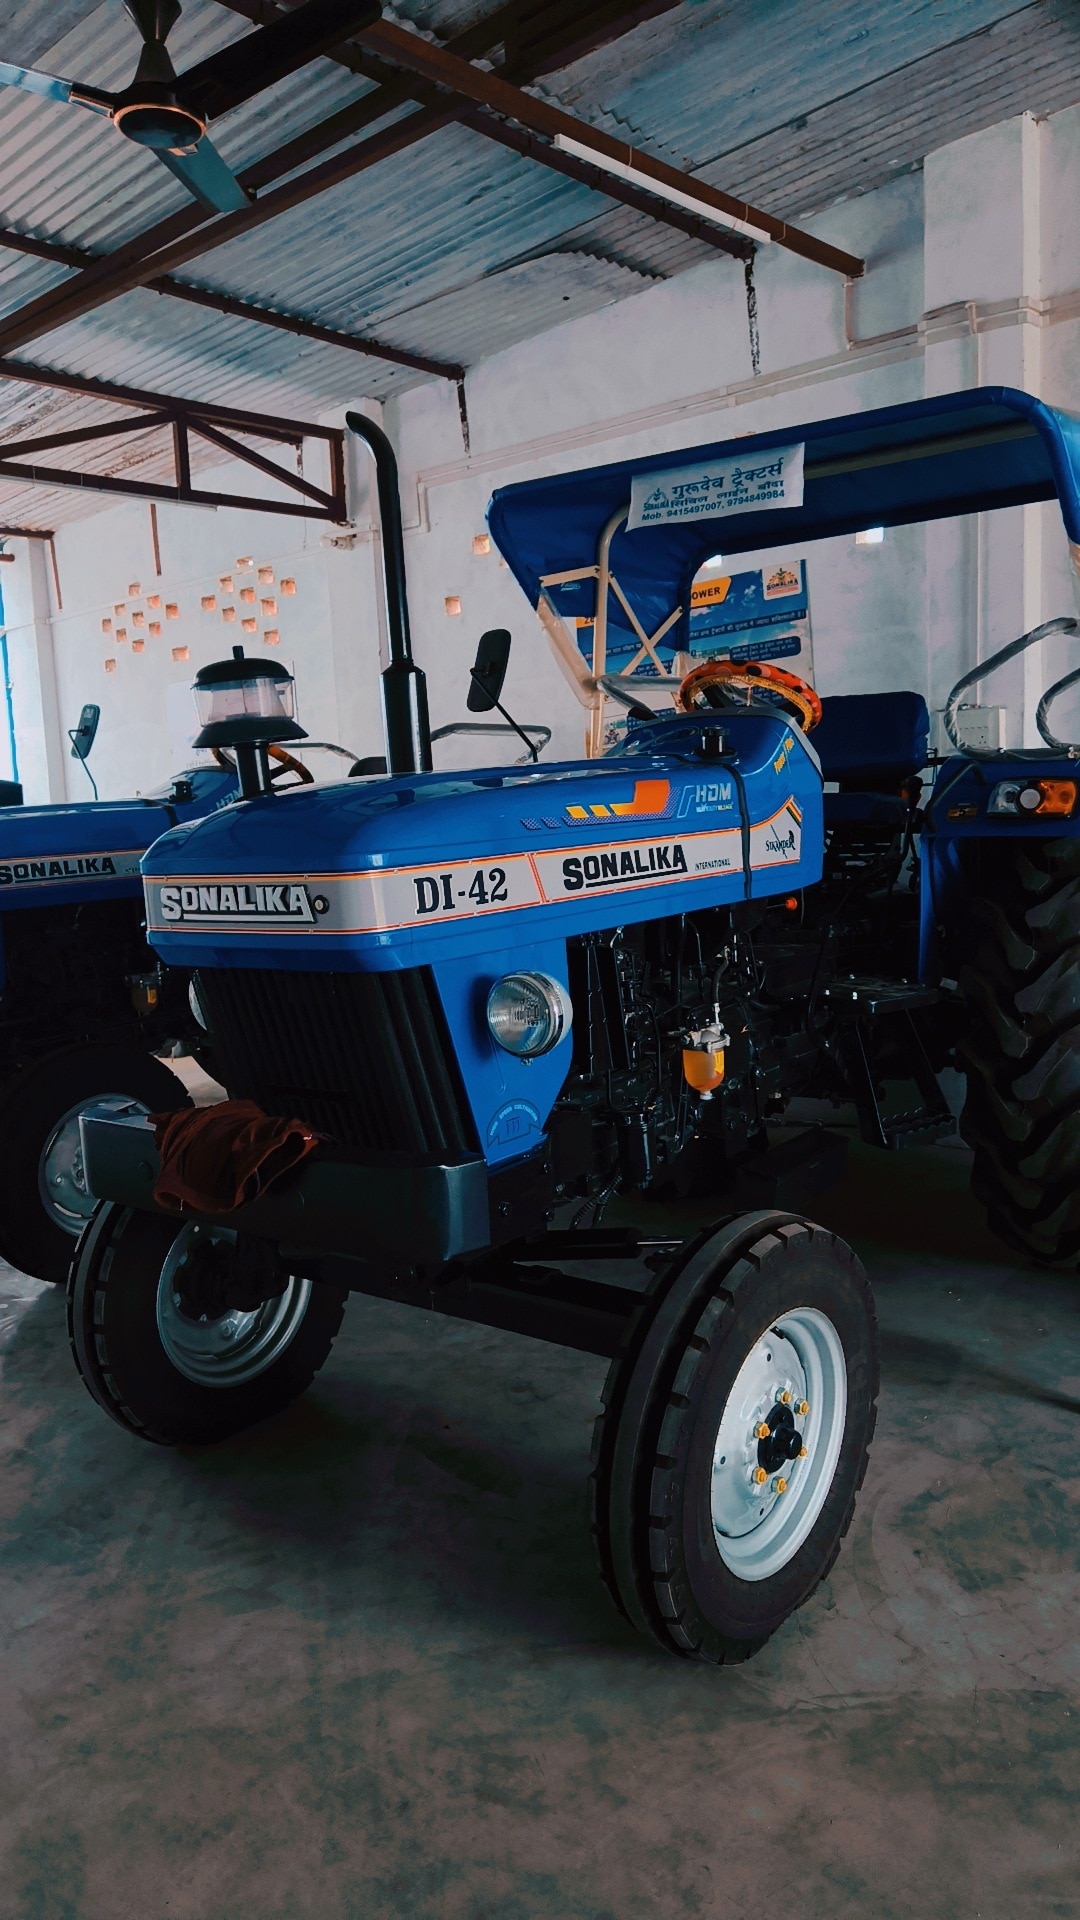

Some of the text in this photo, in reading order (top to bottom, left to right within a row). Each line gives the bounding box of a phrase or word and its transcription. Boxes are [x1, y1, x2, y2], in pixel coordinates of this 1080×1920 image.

[671, 457, 784, 499] गुरूदेव ट्रैक्टर्स
[726, 489, 785, 507] 9794849984
[691, 586, 721, 600] OWER
[695, 782, 732, 803] HDM
[0, 857, 117, 885] SONALIKA
[562, 844, 731, 890] SONALIKA INTERNATIONAL
[160, 885, 317, 923] SONALIKA
[413, 867, 509, 915] DI-42
